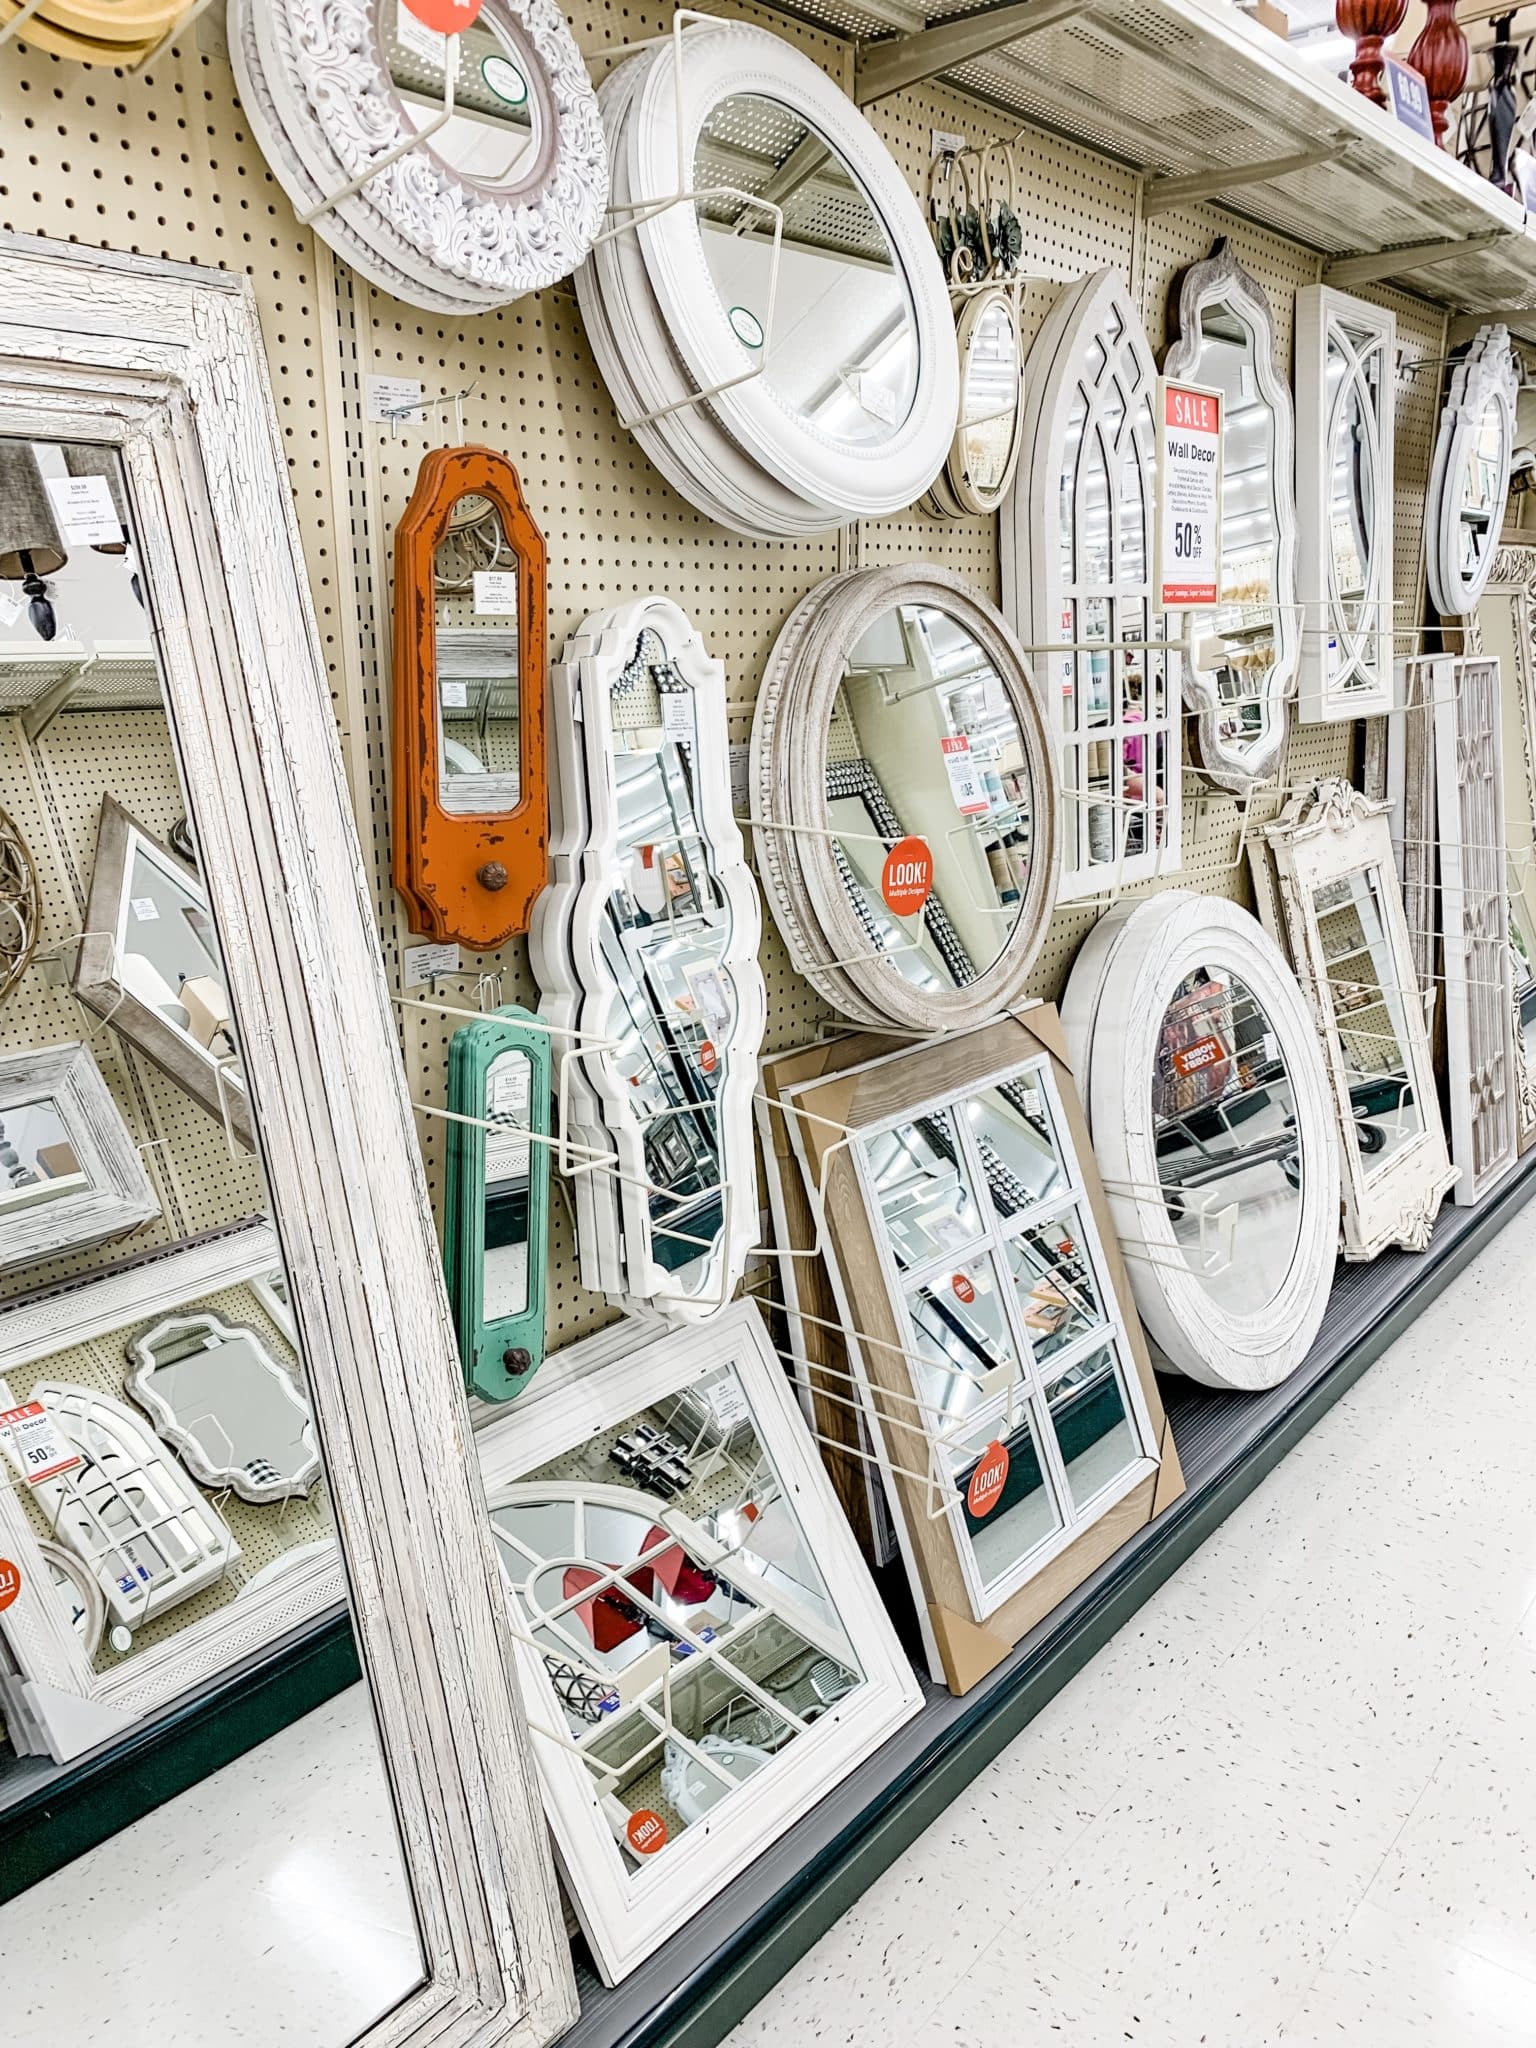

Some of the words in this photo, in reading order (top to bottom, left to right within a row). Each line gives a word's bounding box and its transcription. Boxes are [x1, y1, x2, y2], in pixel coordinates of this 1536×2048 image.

[1175, 395, 1209, 428] SALE
[1168, 440, 1189, 459] Wall
[1191, 444, 1216, 464] Decor
[888, 861, 927, 887] LOOK!
[22, 1417, 47, 1430] Decor
[974, 1460, 1005, 1497] LOOK!
